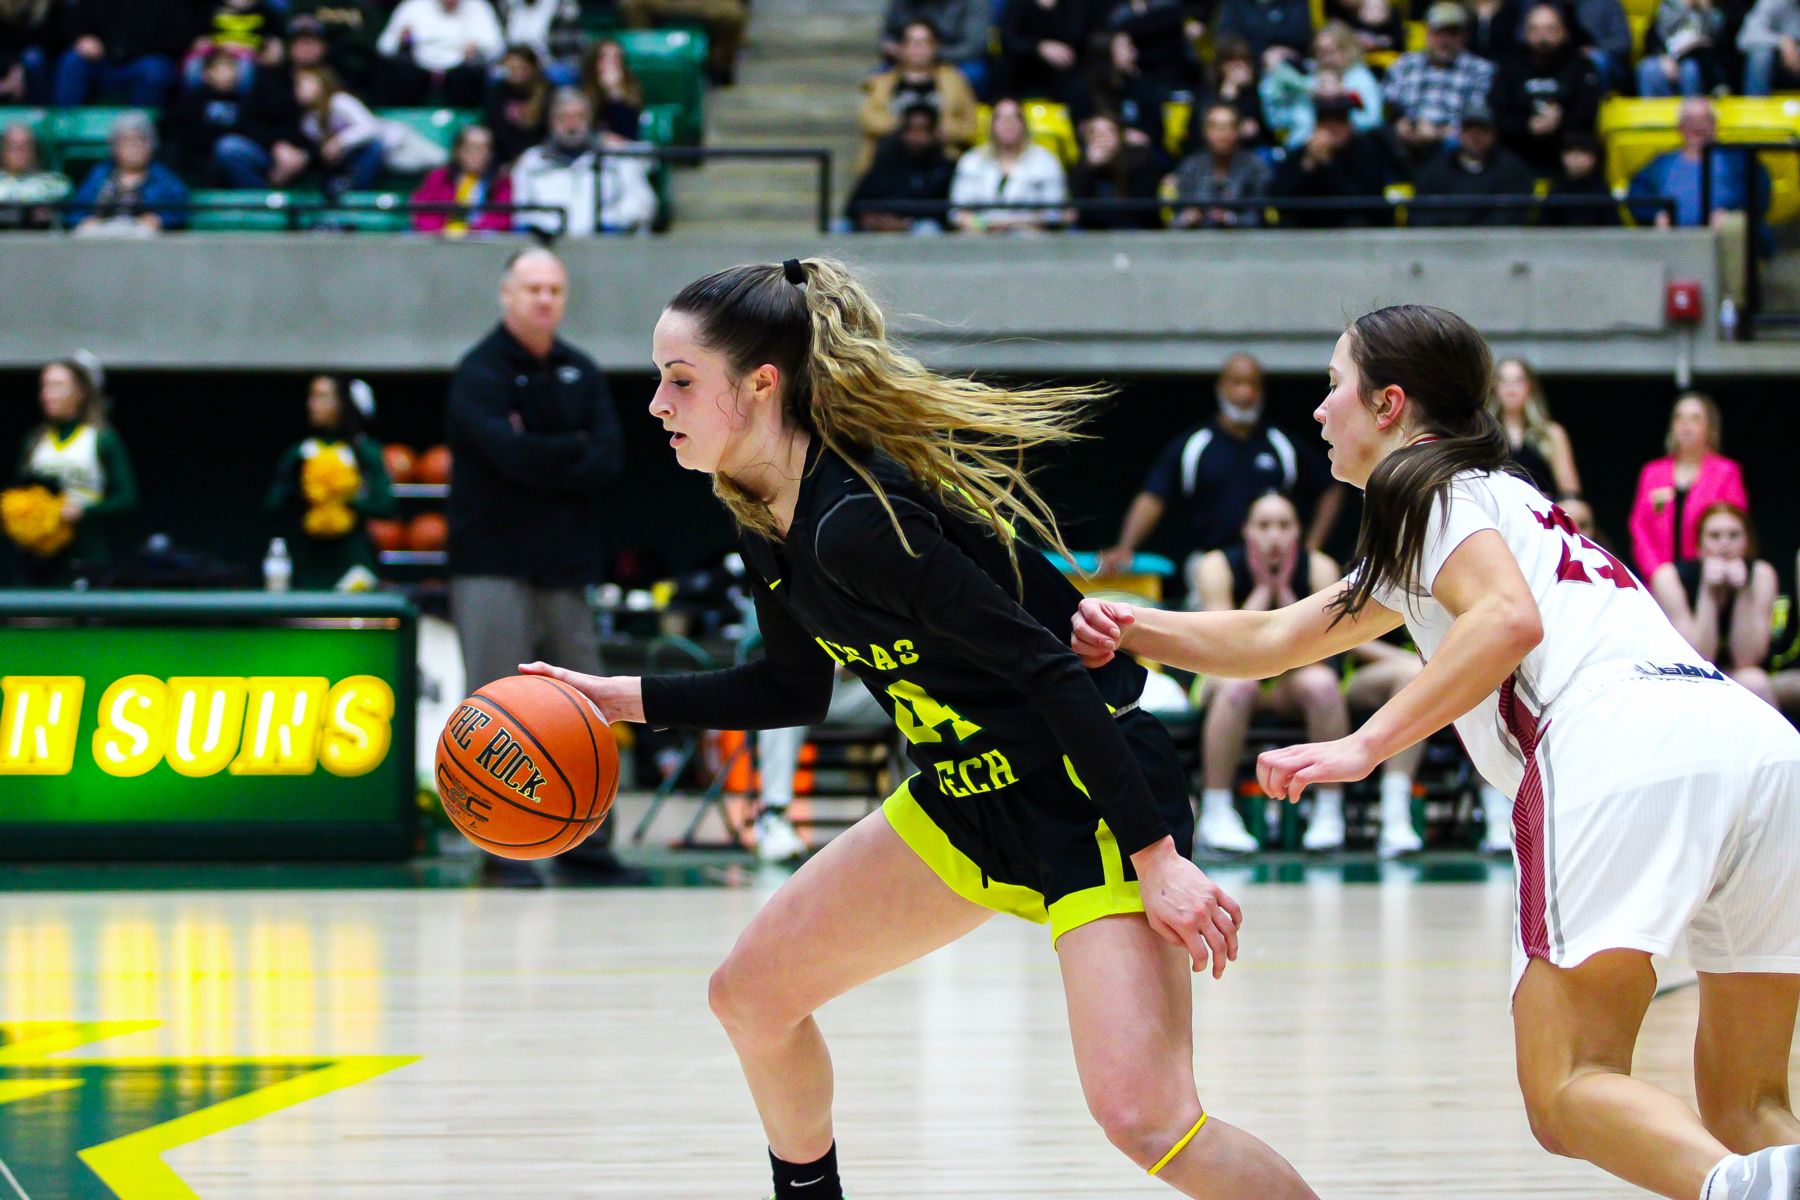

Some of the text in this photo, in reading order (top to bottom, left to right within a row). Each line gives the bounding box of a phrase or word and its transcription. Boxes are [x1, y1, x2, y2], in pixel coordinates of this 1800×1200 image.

[92, 674, 394, 777] SUNS
[449, 705, 548, 803] THE ROCK
